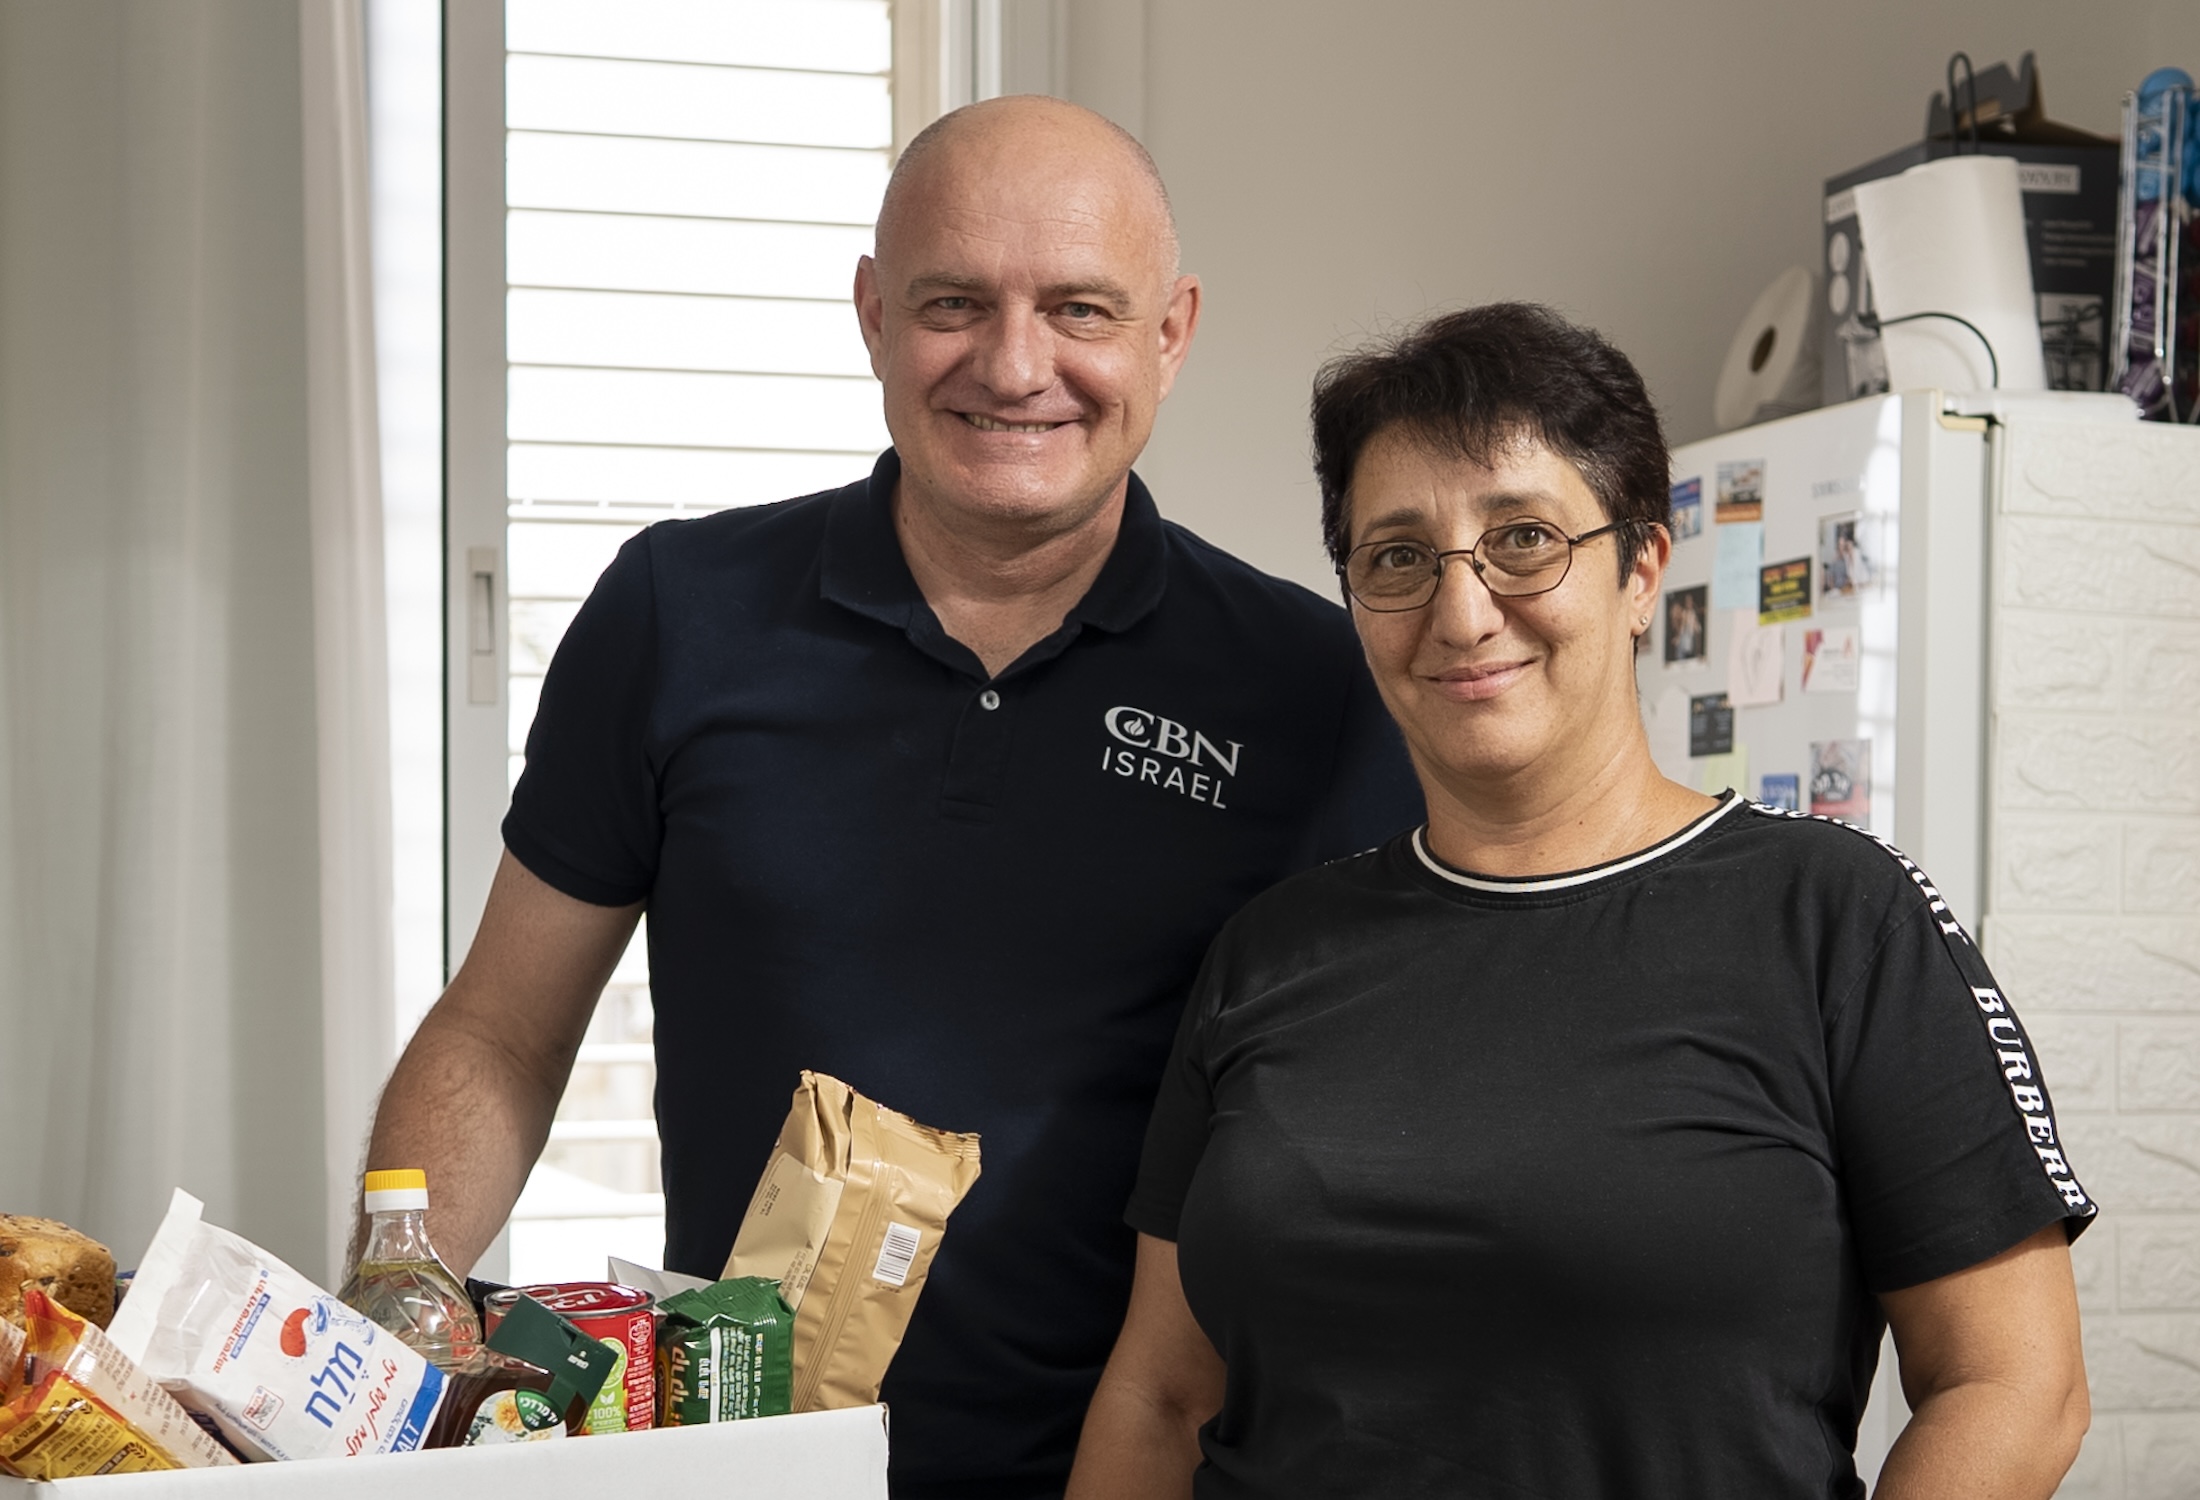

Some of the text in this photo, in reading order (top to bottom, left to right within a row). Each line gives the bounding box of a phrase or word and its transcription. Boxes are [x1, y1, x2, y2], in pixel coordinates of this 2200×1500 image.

[1104, 705, 1245, 778] CBN
[1102, 746, 1227, 810] ISRAEL
[346, 1359, 397, 1457] מלח שולחן מעול
[519, 1396, 550, 1416] מרדכי
[593, 1406, 621, 1419] 100%
[388, 1418, 423, 1453] ALT
